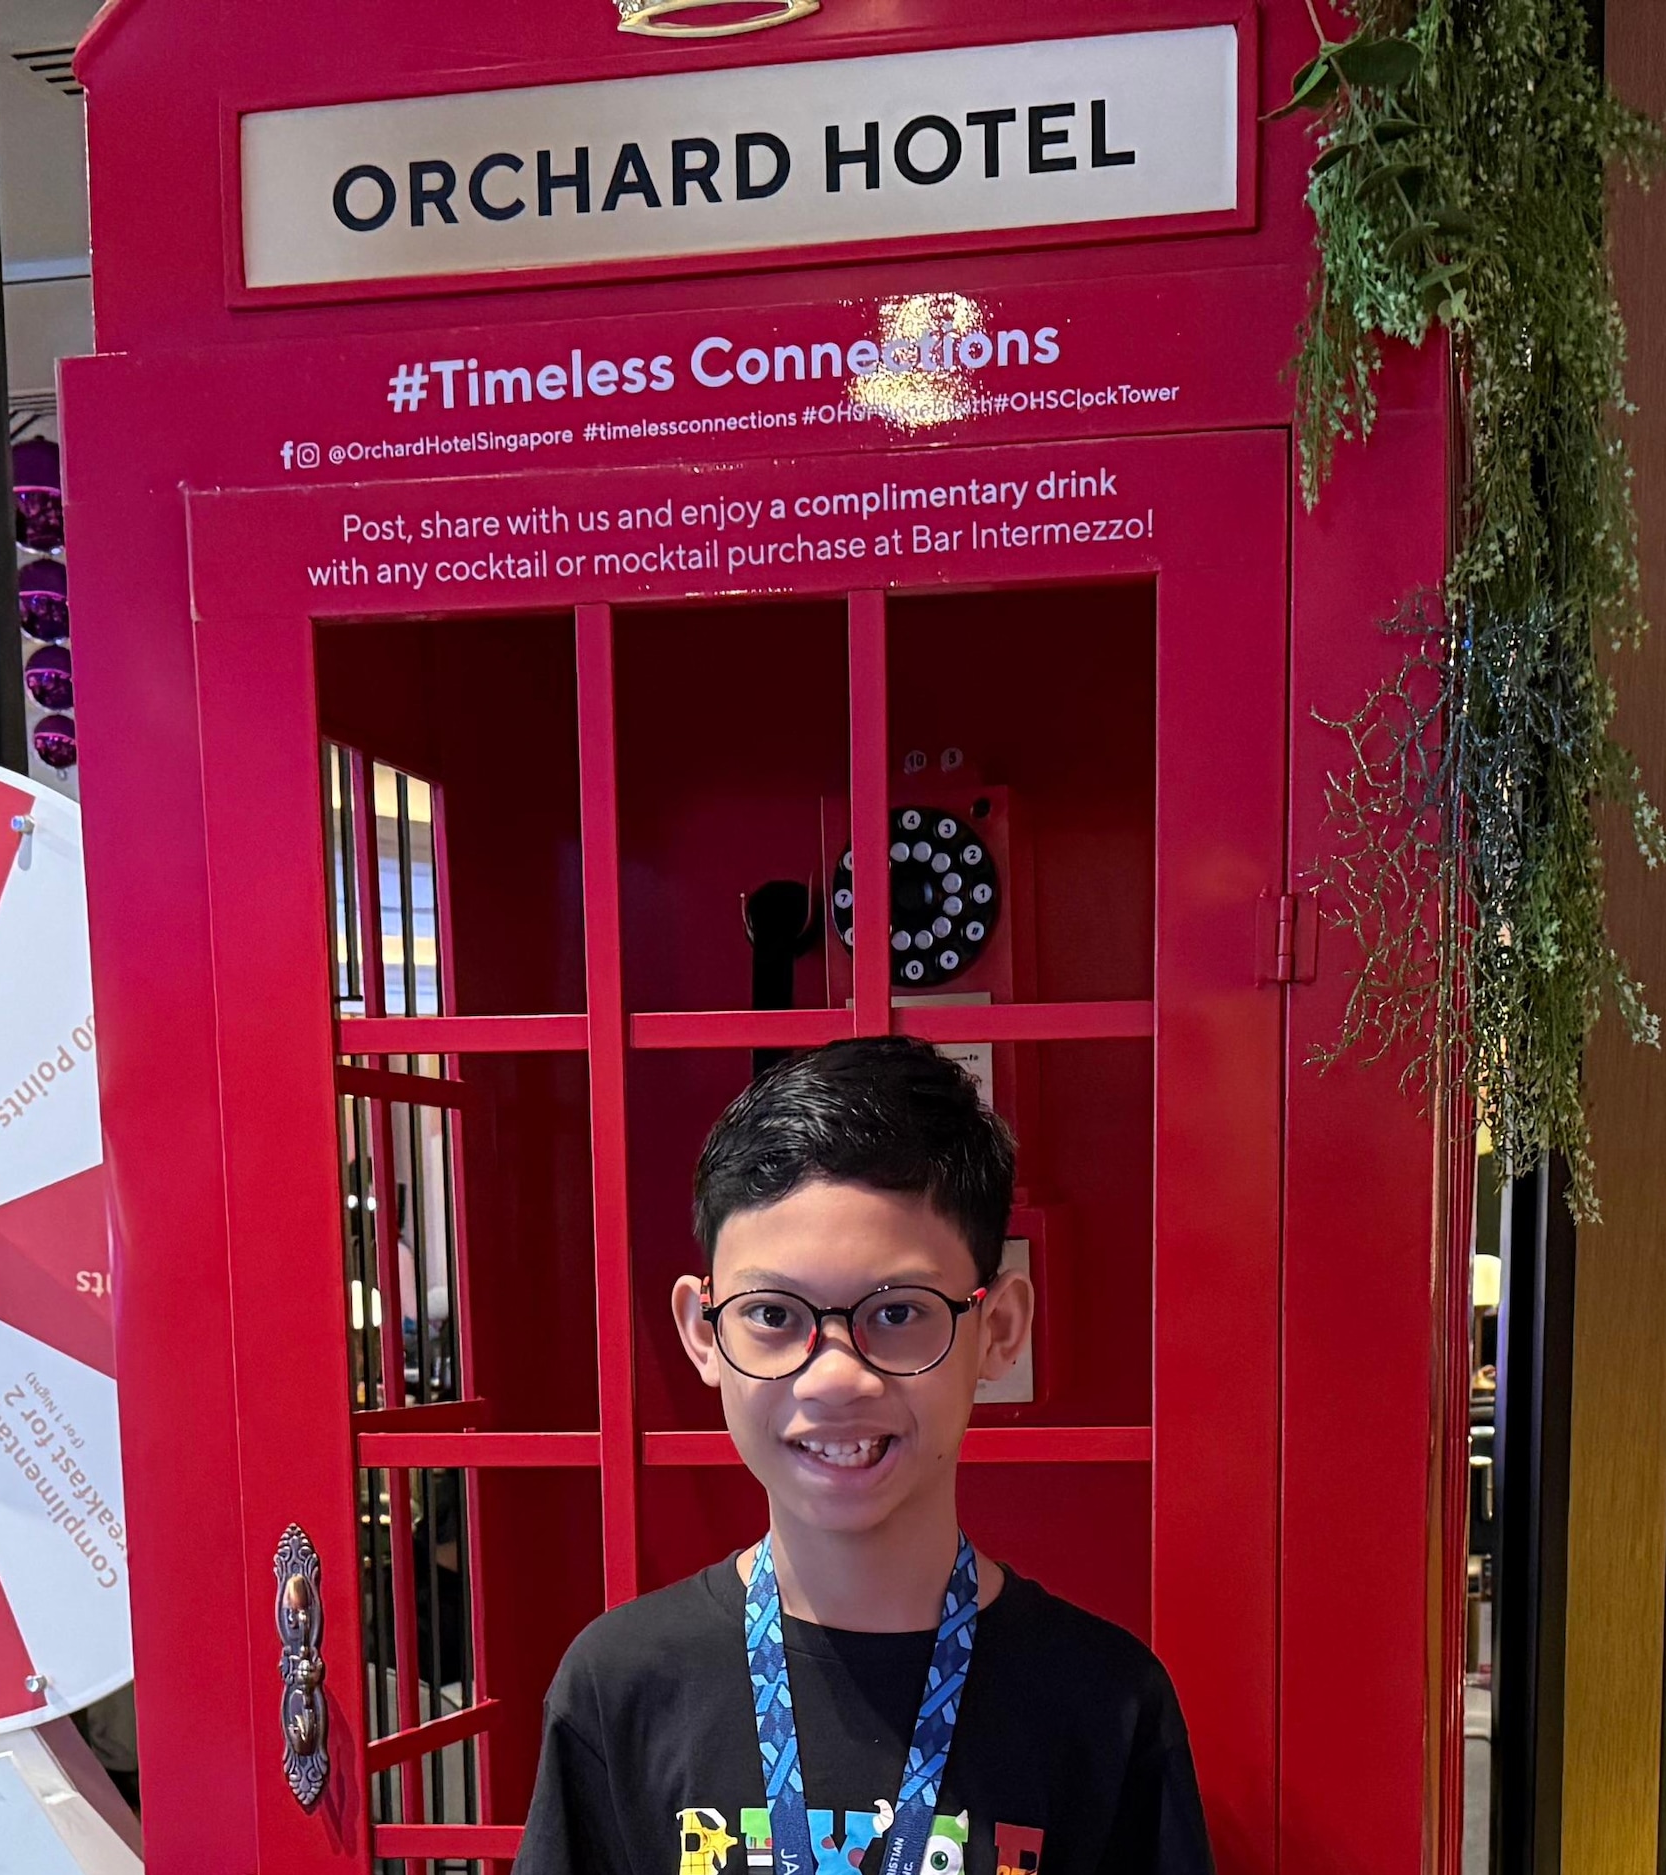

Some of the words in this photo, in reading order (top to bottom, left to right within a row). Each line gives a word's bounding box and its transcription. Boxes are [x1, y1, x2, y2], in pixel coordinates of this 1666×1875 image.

[332, 131, 792, 233] ORCHARD
[824, 98, 1136, 194] HOTEL
[387, 349, 675, 413] #Timeless
[690, 321, 1061, 388] Connections
[328, 427, 574, 464] @OrchardHotelSingapore
[583, 410, 797, 442] #timelessconnections
[342, 514, 413, 543] Post,
[420, 510, 500, 539] share
[507, 506, 569, 535] with
[577, 508, 610, 531] us
[617, 499, 672, 528] and
[681, 495, 762, 530] enjoy
[770, 499, 786, 519] a
[794, 479, 1029, 520] complimentary
[1036, 467, 1117, 499] drink
[307, 558, 369, 587] with
[376, 561, 428, 590] any
[435, 551, 548, 583] cocktail
[555, 554, 586, 577] or
[594, 540, 719, 575] mocktail
[728, 533, 866, 574] purchase
[874, 529, 903, 556] at
[912, 524, 964, 554] Bar
[972, 509, 1154, 550] Intermezzo!
[4, 1384, 25, 1407] 2
[25, 1371, 57, 1414] Night)
[20, 1409, 55, 1448] for
[62, 1423, 85, 1449] (For
[51, 1445, 125, 1552] eakfast
